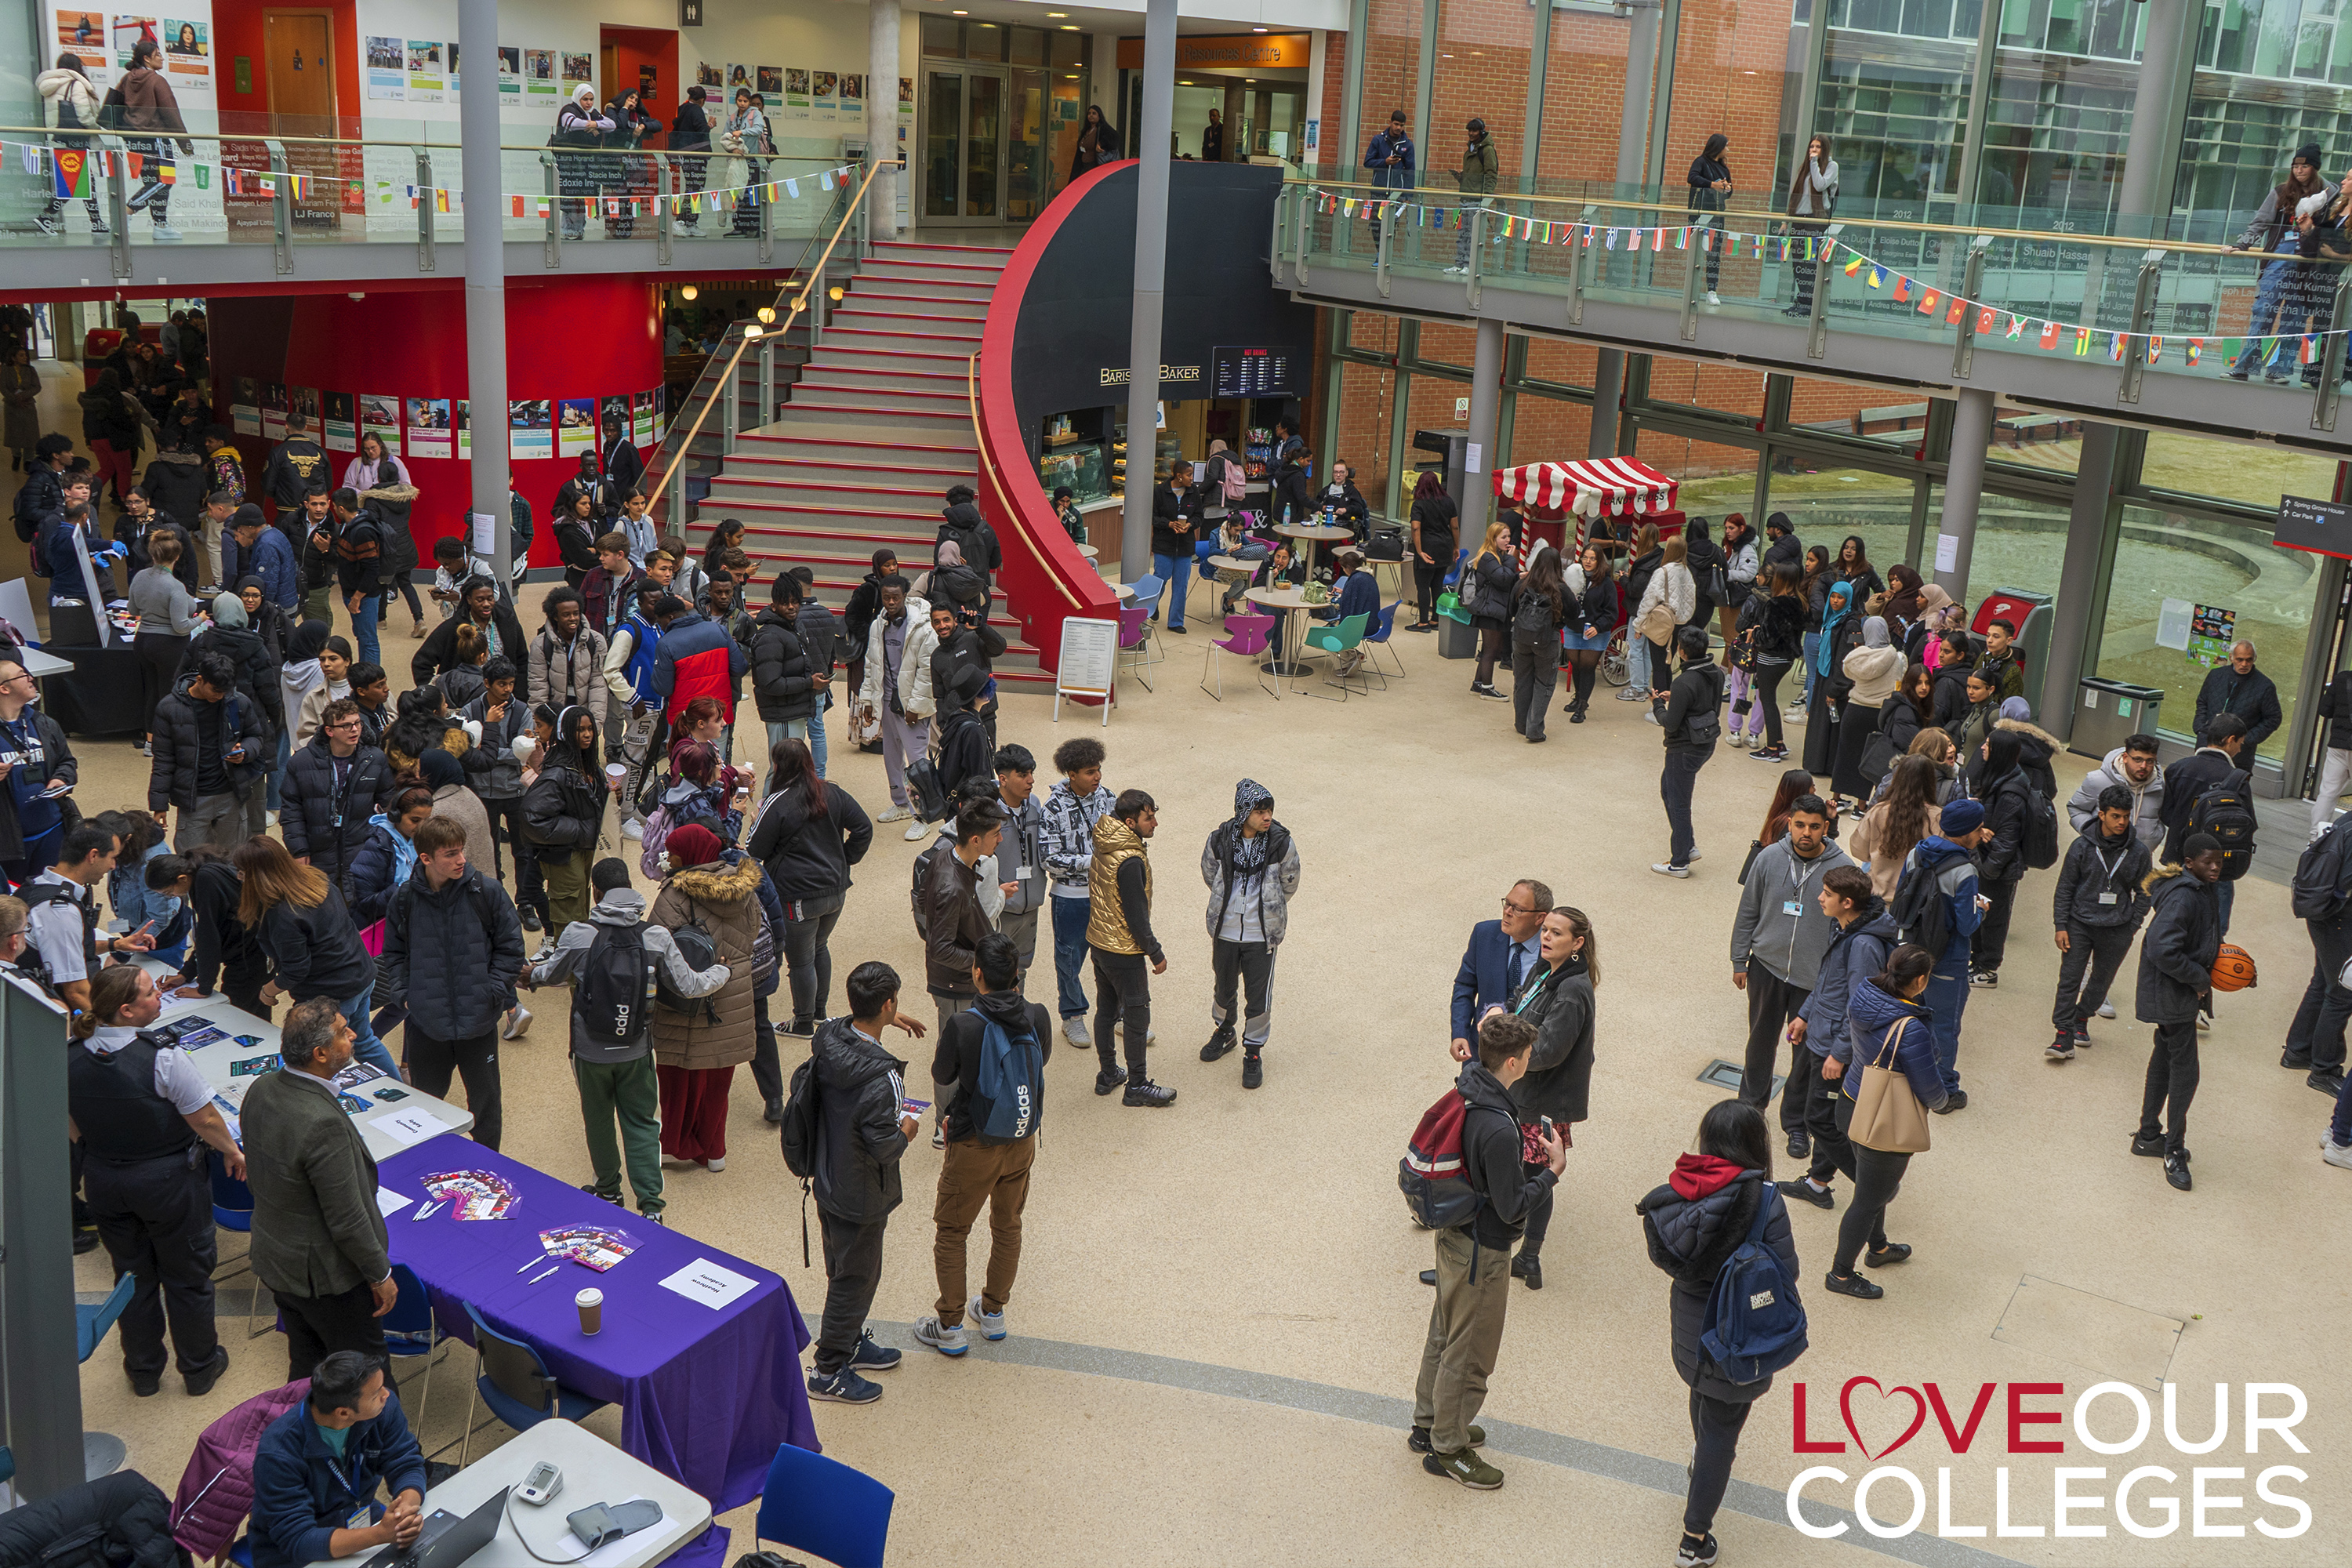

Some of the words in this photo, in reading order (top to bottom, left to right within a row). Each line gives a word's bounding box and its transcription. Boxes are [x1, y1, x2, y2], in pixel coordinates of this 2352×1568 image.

[1184, 45, 1240, 62] Resources
[1242, 43, 1281, 62] Centre
[125, 140, 152, 151] Hafsa
[295, 210, 305, 219] LJ
[307, 210, 336, 219] Franco
[1893, 210, 1912, 220] 2012
[2053, 221, 2074, 230] 2012
[2024, 245, 2056, 258] Shuaib
[2059, 249, 2094, 262] Hassan
[2280, 268, 2307, 279] Arthur
[2275, 280, 2303, 291] Rahul
[2303, 282, 2336, 294] Kumar
[2278, 292, 2306, 303] Marina
[2262, 302, 2299, 316] Presha
[1158, 365, 1200, 380] BAKER
[1604, 496, 1633, 506] CANDY
[1637, 492, 1664, 503] FLOSS
[2293, 501, 2310, 510] Spring
[638, 720, 651, 734] LOS
[2225, 828, 2239, 837] CAT
[1014, 1084, 1031, 1138] adidas
[395, 1120, 418, 1134] Community
[408, 1118, 423, 1129] Safety
[691, 1278, 720, 1294] Heathrow
[699, 1273, 728, 1289] Academy
[1750, 1290, 1771, 1301] SUPER
[1454, 1459, 1471, 1474] PUMA
